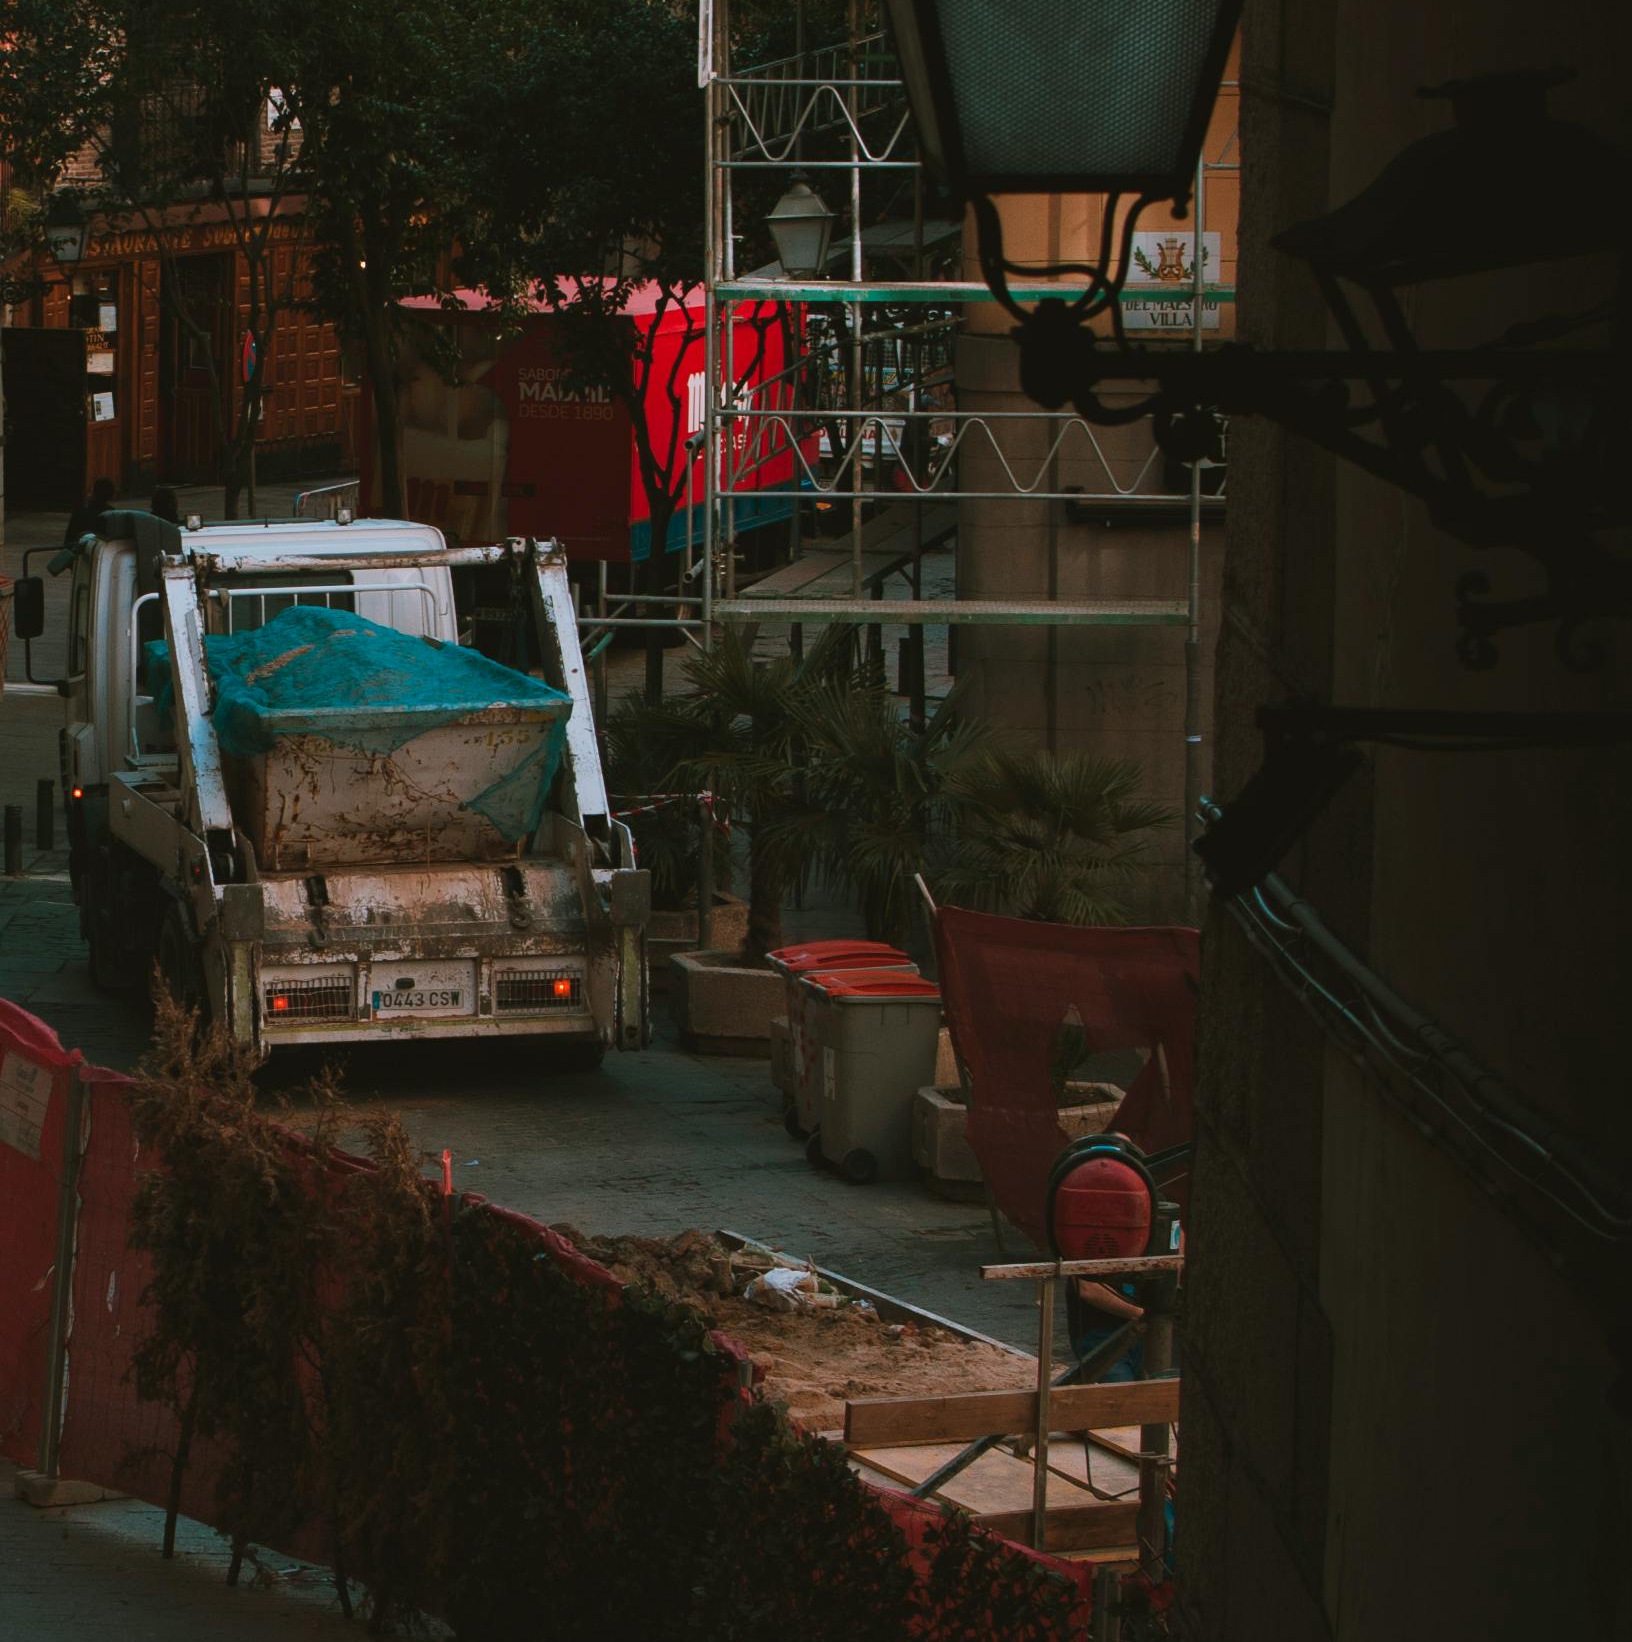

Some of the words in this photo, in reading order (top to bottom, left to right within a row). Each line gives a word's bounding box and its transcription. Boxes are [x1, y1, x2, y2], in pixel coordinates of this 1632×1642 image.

[1152, 300, 1217, 311] MAESRO
[1150, 312, 1193, 326] VILLA
[519, 404, 568, 418] DESDE
[575, 405, 614, 421] 1890
[383, 992, 425, 1008] 0443
[429, 991, 460, 1007] CSW
